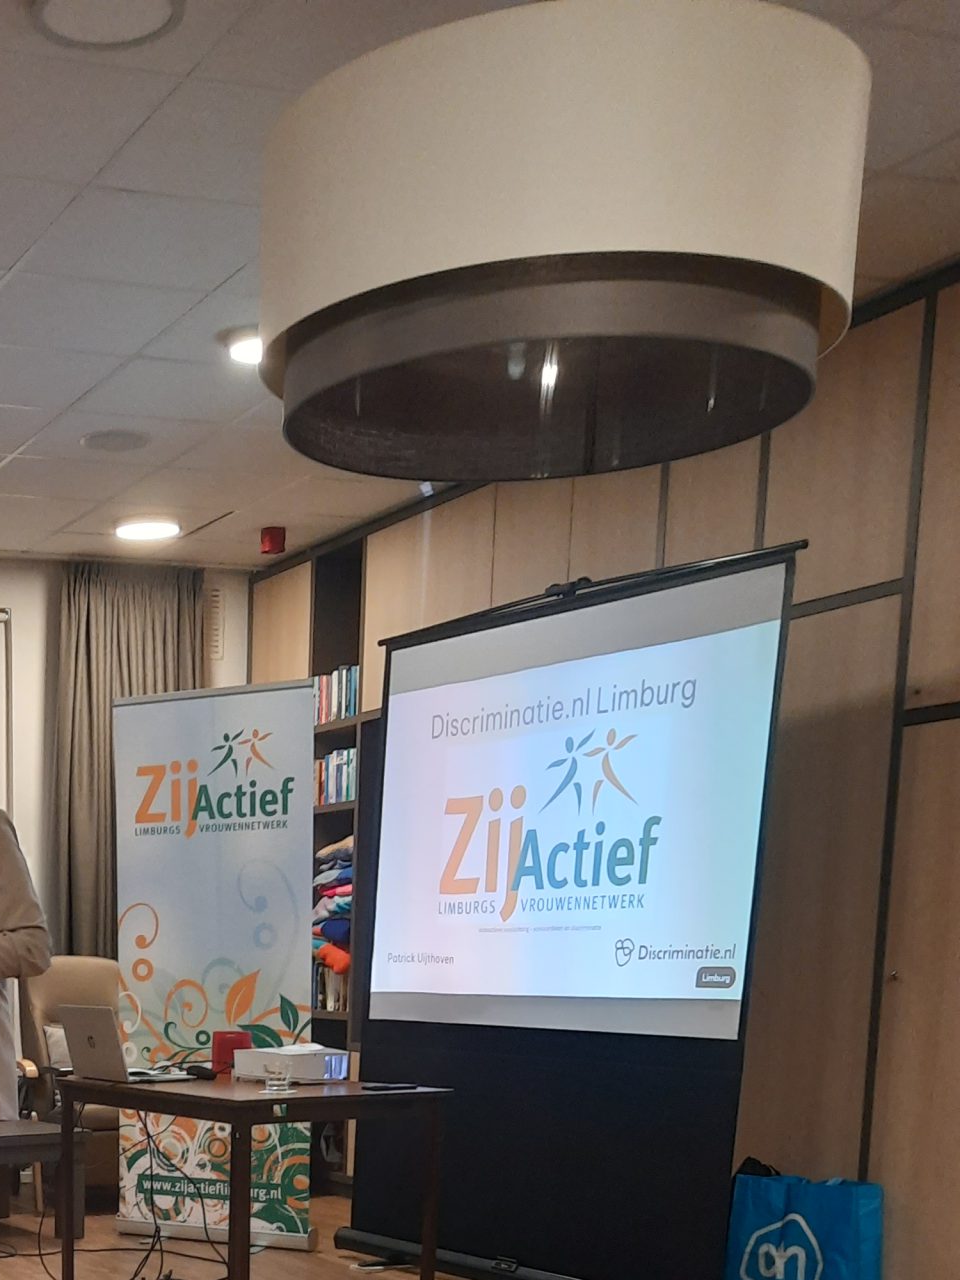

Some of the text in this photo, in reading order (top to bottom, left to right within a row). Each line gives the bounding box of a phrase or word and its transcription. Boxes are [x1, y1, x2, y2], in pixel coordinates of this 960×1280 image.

[432, 679, 697, 739] Discriminatie.nl Limburg
[135, 819, 289, 837] LIMBURGS VROUWENNETWERK
[438, 894, 645, 915] LIMBURGS VROUWENNETWERK
[387, 952, 415, 964] Patrick
[638, 943, 736, 960] Discriminatie.nl
[701, 973, 731, 984] Limburg
